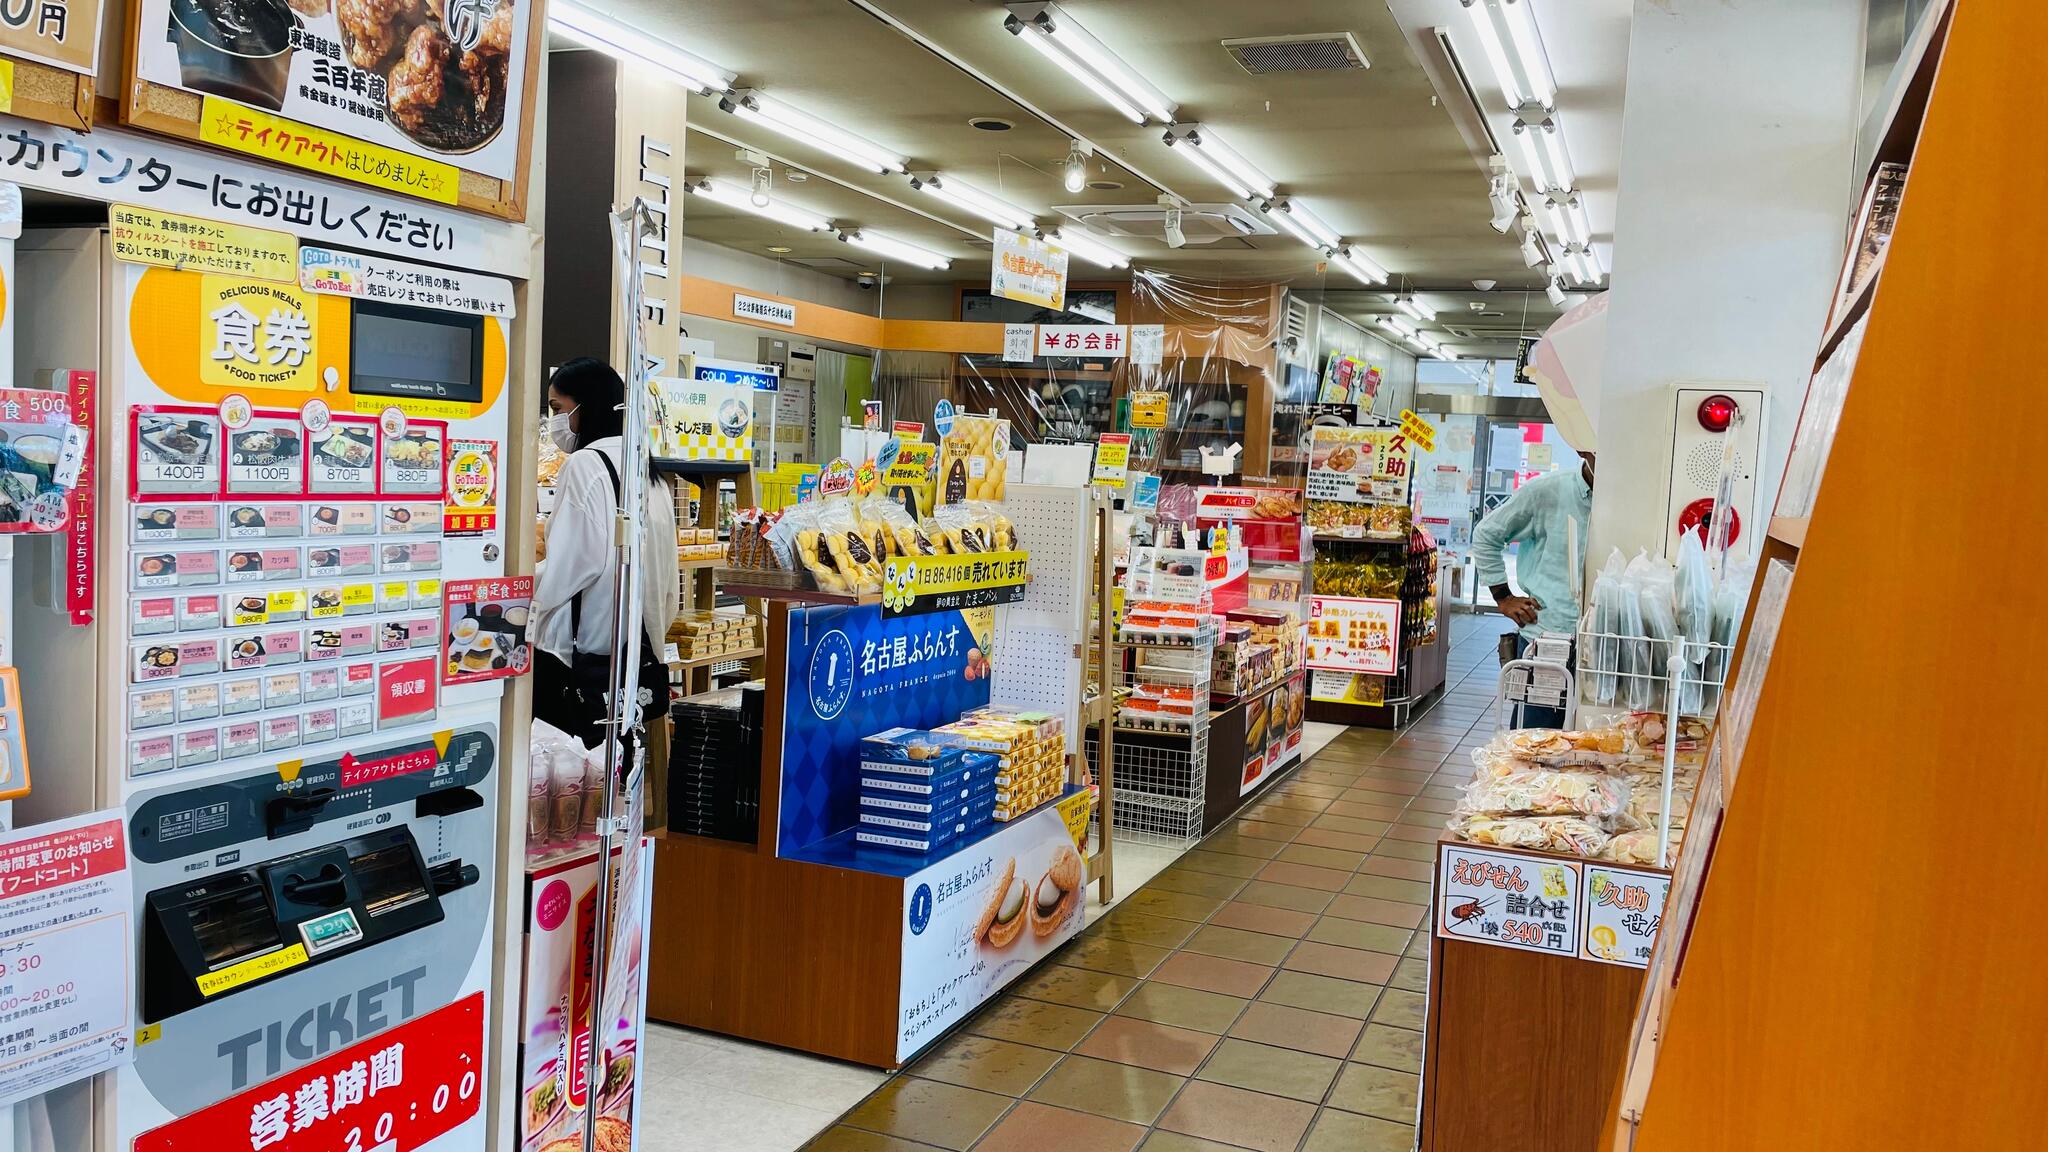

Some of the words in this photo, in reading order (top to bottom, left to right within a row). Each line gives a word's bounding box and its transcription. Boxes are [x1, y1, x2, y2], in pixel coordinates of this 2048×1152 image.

[311, 57, 388, 104] 三百年蔵
[235, 117, 431, 191] テイクアウトはじめました
[0, 128, 455, 252] カウンターにお出しください
[115, 211, 225, 239] 当店では、食券機ボタンに
[115, 226, 291, 265] 抗ウィルスシートを施工しておりますので、
[116, 242, 256, 273] 安心してお買い求めいただけます。
[334, 255, 361, 270] トラベル
[366, 266, 461, 292] クーポンご利用の際は
[219, 285, 270, 301] DELICIOUS
[272, 289, 302, 311] MEALS
[367, 283, 506, 313] 売店レジまでお申しつけ願います
[210, 302, 312, 367] 食券
[1006, 328, 1033, 336] cashier
[229, 366, 256, 382] FOOD
[258, 369, 292, 383] TICKET
[700, 370, 727, 381] COLD
[1, 399, 22, 421] 食
[30, 397, 65, 413] 500
[674, 421, 713, 435] よしだ麺
[59, 433, 79, 479] 塩サバ
[1385, 434, 1407, 477] 久助
[155, 466, 205, 480] 1400円
[245, 467, 290, 480] 1100円
[327, 468, 360, 481] 870円
[396, 470, 428, 482] 880円
[76, 375, 89, 598] 【テイクメニュー】はこちらです
[33, 502, 66, 520] 10:30
[44, 494, 62, 507] AM
[37, 516, 56, 529] まで
[476, 582, 510, 600] 朝定食
[513, 579, 531, 591] 500
[859, 624, 960, 676] 名古屋ふらんす。
[390, 678, 426, 699] 領収書
[861, 683, 894, 698] NAGOYA
[899, 675, 929, 689] FRANCE
[230, 727, 257, 738] 伊勢うどん
[306, 772, 336, 785] 硬貨投入口
[343, 755, 430, 782] テイクアウトはこちら
[0, 835, 115, 874] 時間変更のお知らせ
[217, 852, 239, 864] TICKET
[1451, 857, 1529, 892] えびせん
[1504, 892, 1571, 920] 詰合せ
[1599, 880, 1651, 912] 久助
[1502, 918, 1543, 946] 540
[1547, 931, 1564, 949] 円
[142, 1030, 151, 1043] 2
[217, 964, 427, 1091] TICKET
[250, 1042, 405, 1152] 営業時間
